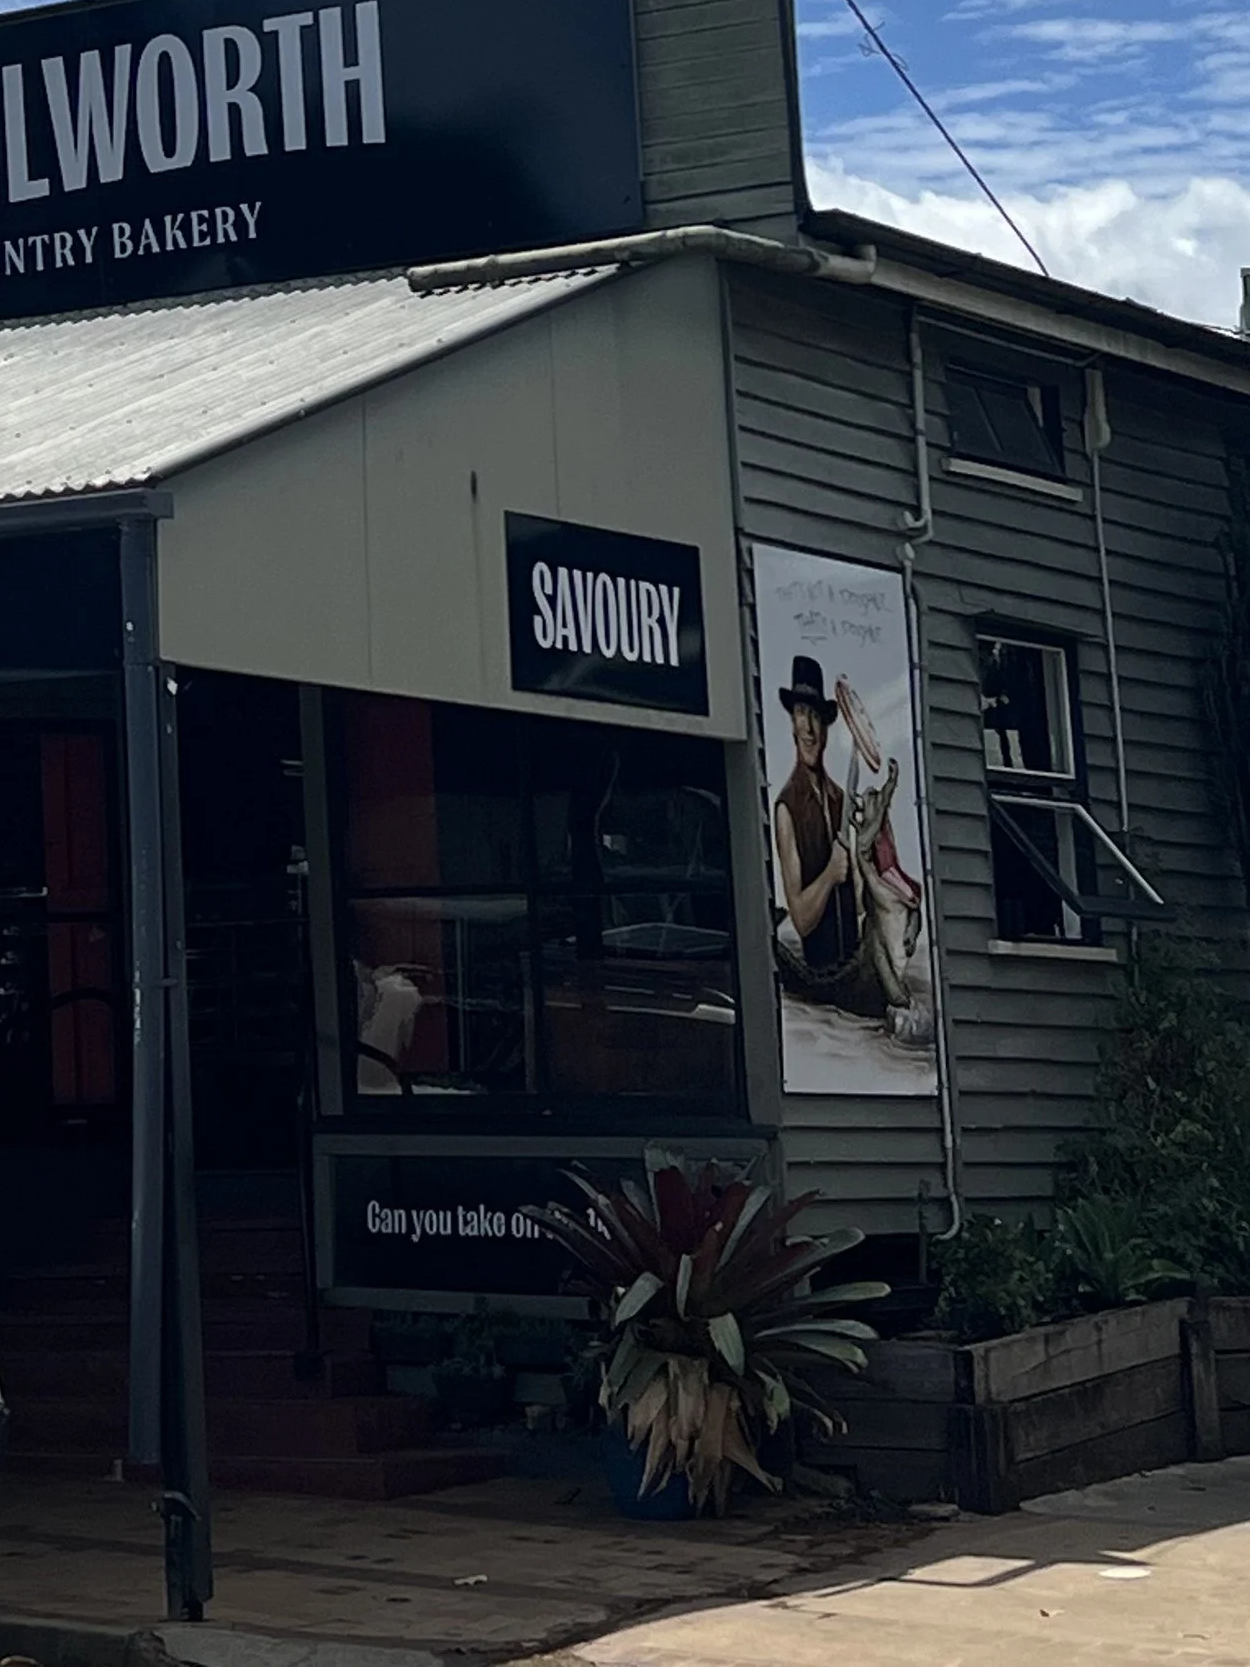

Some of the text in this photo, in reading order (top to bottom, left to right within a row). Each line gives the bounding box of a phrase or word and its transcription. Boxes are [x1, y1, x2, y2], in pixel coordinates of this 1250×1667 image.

[112, 201, 262, 259] BAKERY
[530, 561, 681, 667] SAVOURY
[366, 1200, 407, 1234] Can
[411, 1208, 452, 1243] you
[457, 1203, 506, 1238] take
